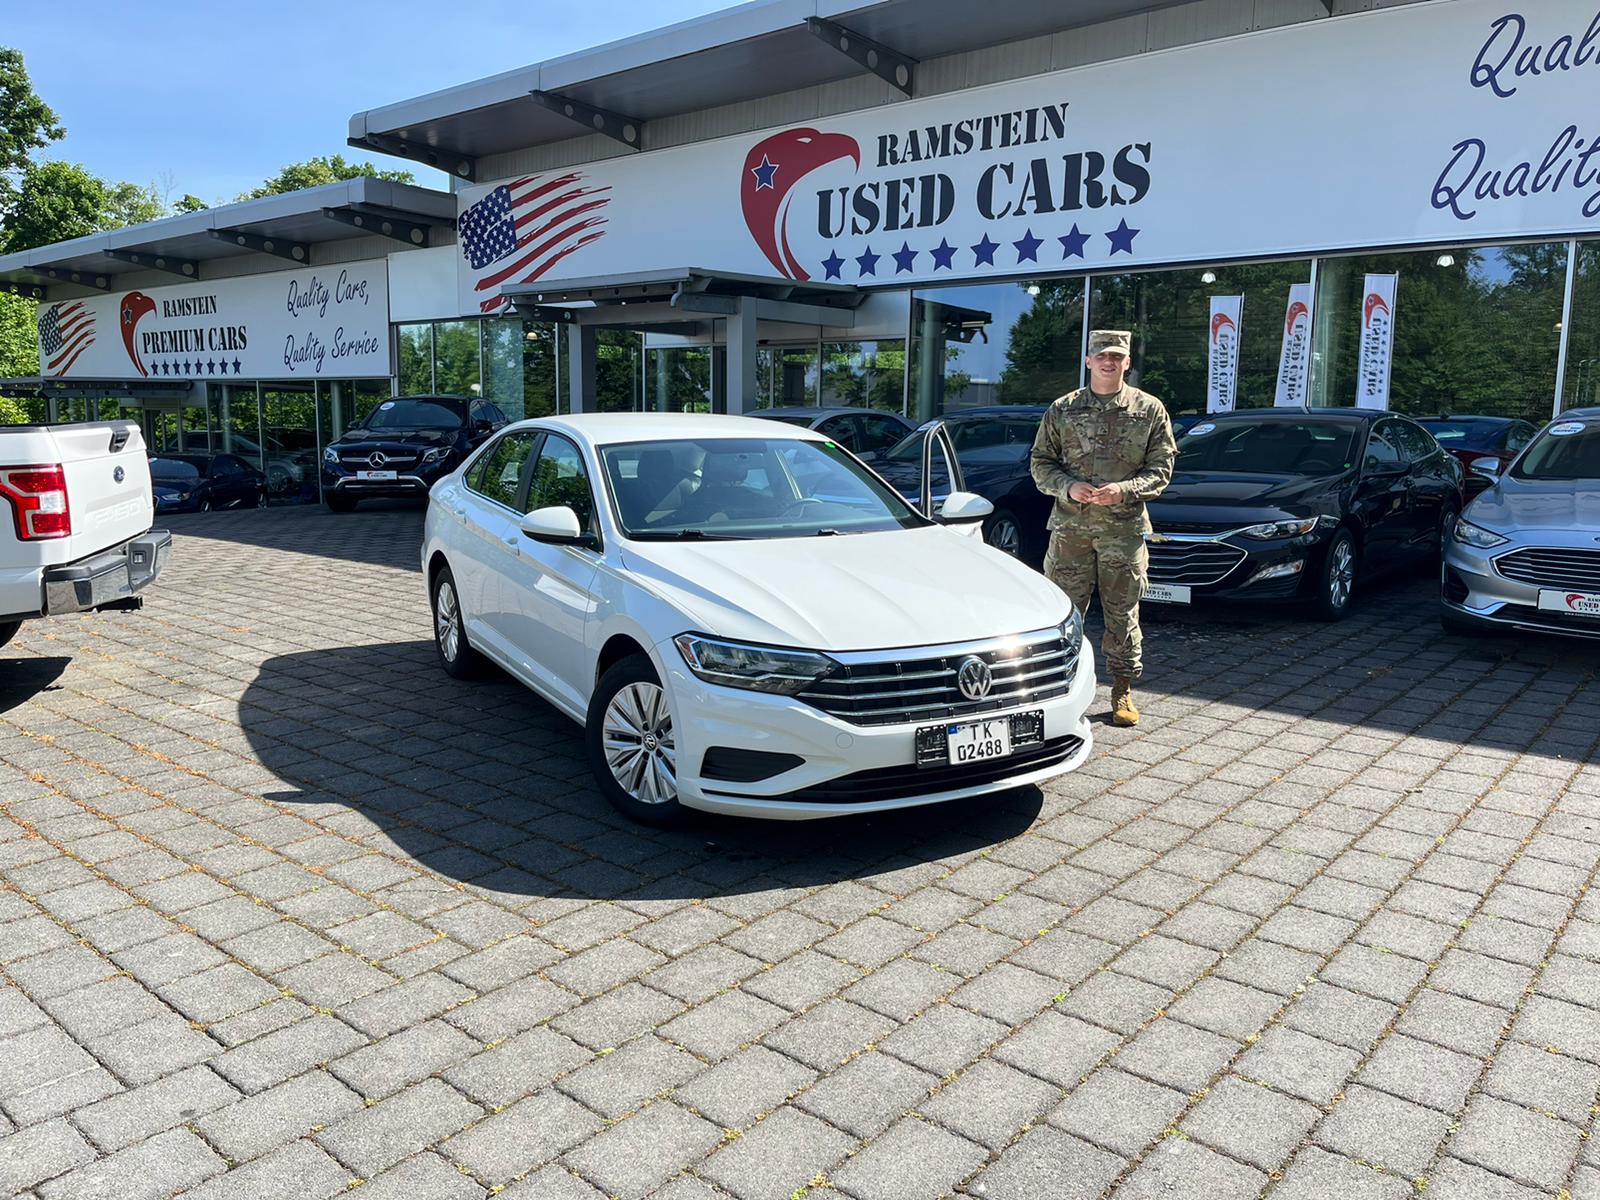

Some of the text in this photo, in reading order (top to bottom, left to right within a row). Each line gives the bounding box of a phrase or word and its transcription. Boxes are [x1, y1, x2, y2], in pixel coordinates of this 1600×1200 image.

[1470, 11, 1600, 98] Qual
[876, 102, 1069, 167] RAMSTEIN
[815, 141, 1152, 239] USED CARS
[163, 295, 217, 318] RAMSTEIN
[287, 269, 369, 318] Quality Cars,
[142, 325, 248, 354] PREMIUM CARS
[284, 326, 379, 373] Quality Service
[957, 739, 1002, 761] 02488
